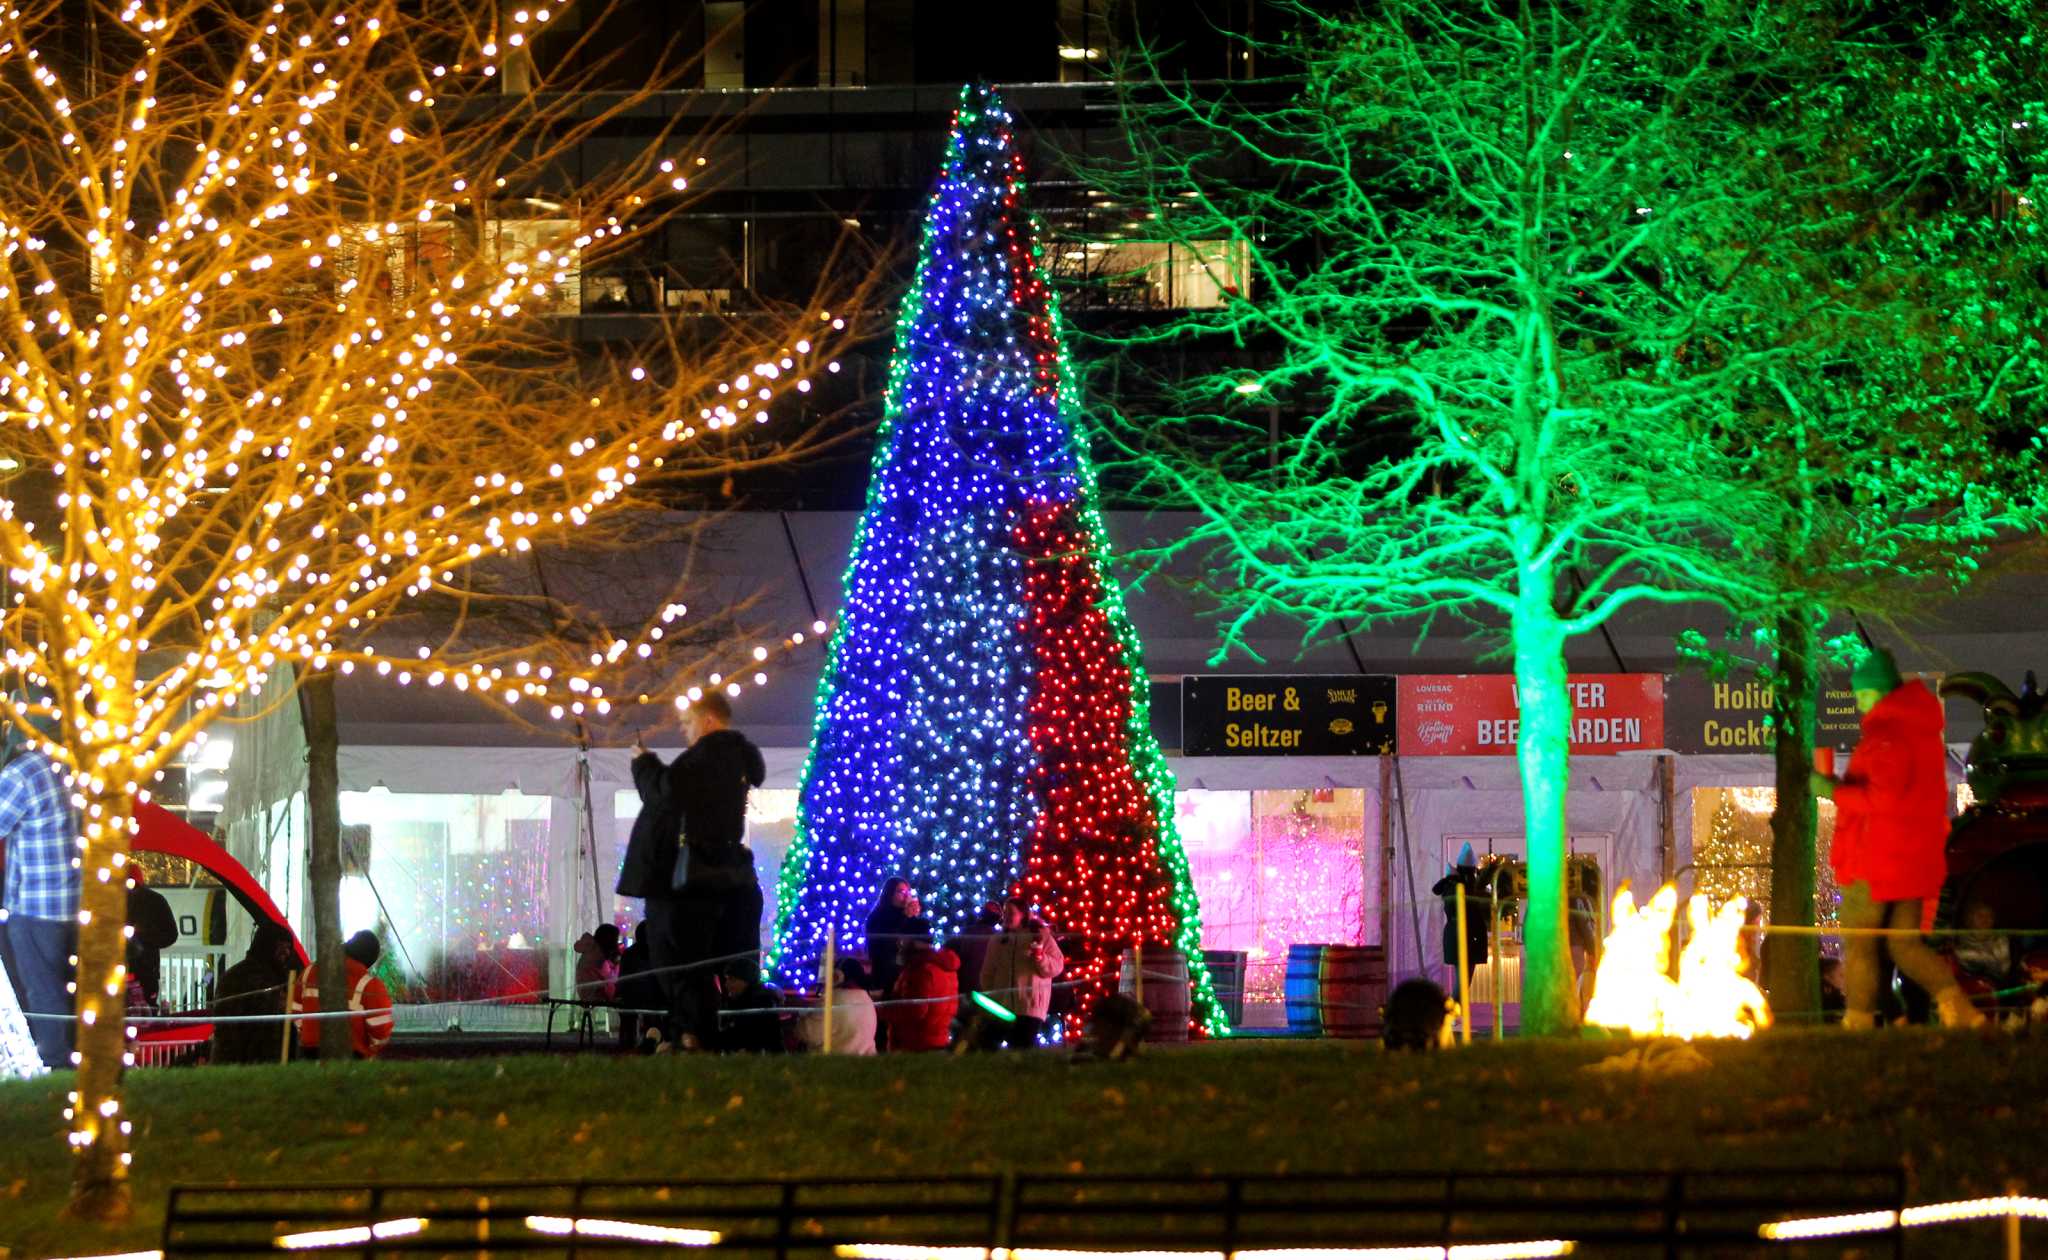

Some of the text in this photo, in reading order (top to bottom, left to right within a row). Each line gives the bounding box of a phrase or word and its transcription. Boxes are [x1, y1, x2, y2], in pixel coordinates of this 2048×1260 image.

[1226, 686, 1301, 712] Beer &
[1511, 682, 1606, 709] TER
[1713, 682, 1774, 710] Holid
[1225, 722, 1303, 748] Seltzer
[1478, 717, 1641, 745] BEE ARDEN
